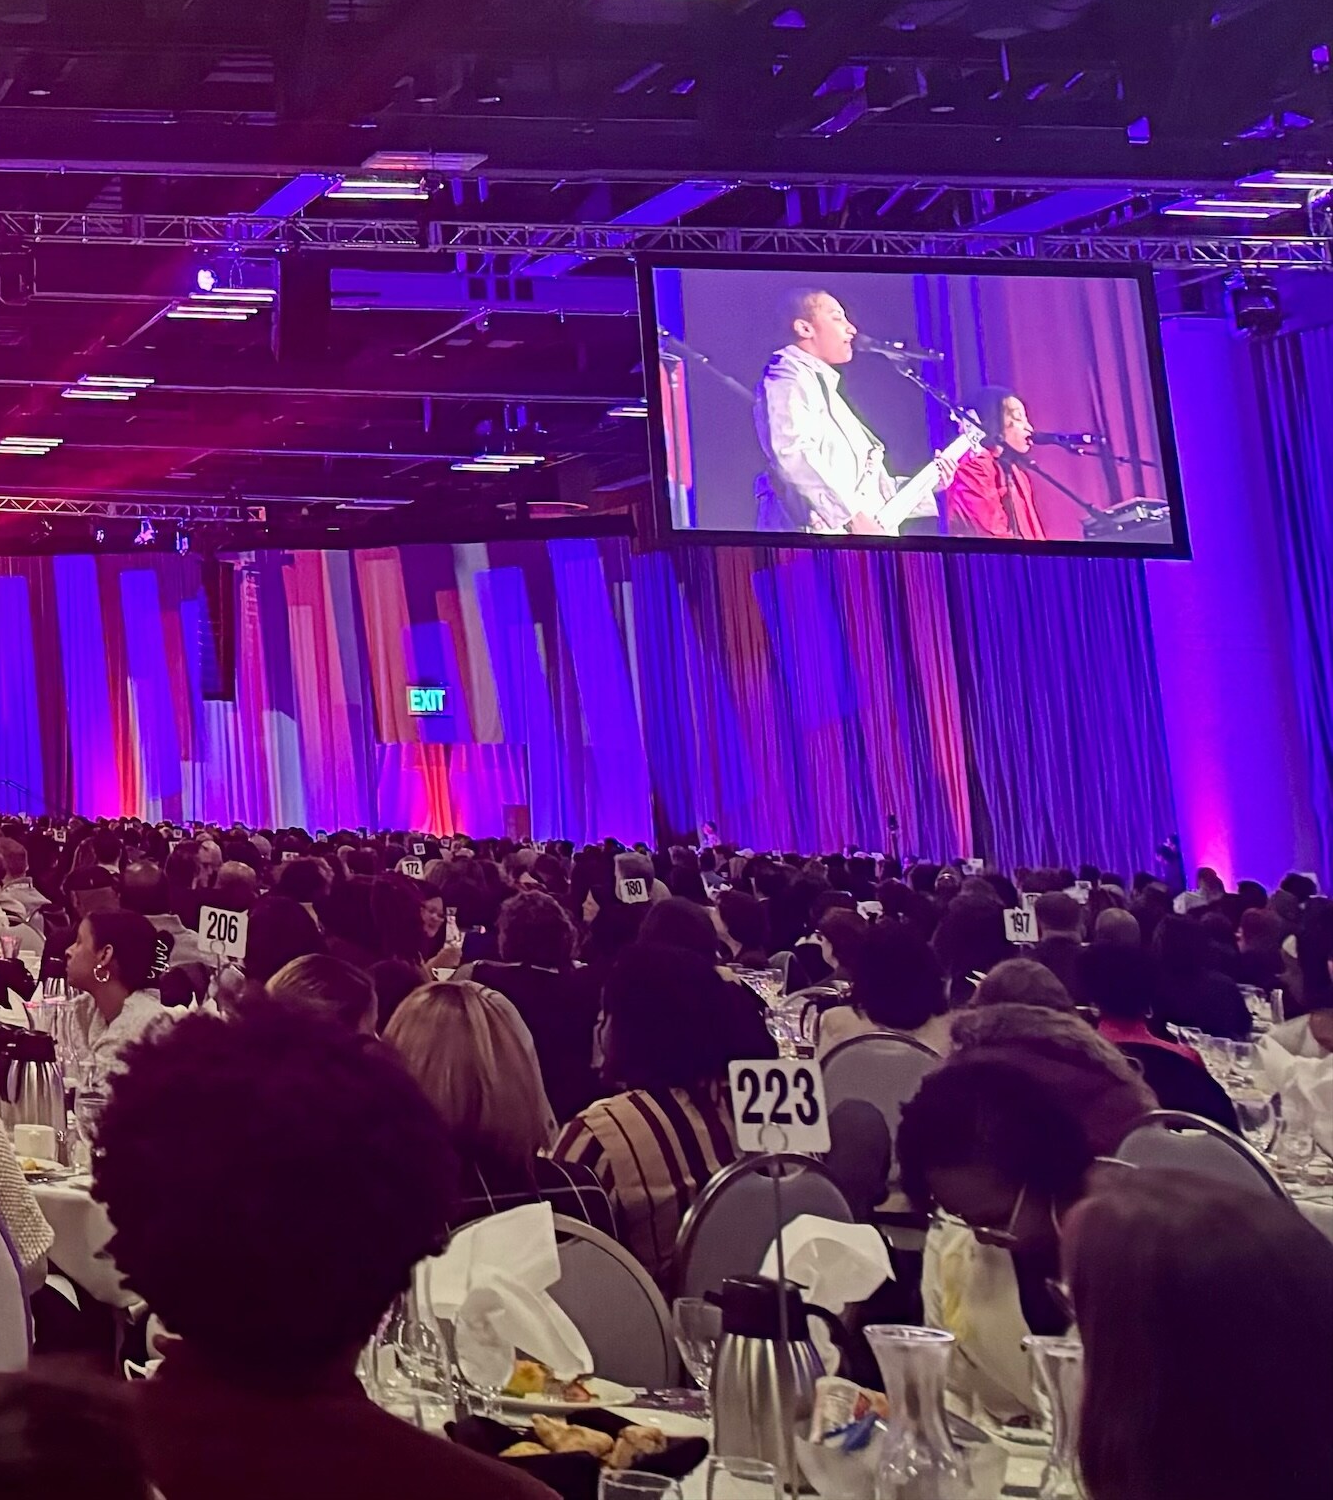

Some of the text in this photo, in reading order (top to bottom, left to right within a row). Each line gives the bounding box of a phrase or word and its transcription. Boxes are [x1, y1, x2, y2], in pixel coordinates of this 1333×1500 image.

[410, 689, 445, 712] EXIT
[405, 862, 421, 875] 172
[206, 911, 238, 944] 206
[1010, 912, 1030, 933] 197
[737, 1067, 820, 1126] 223
